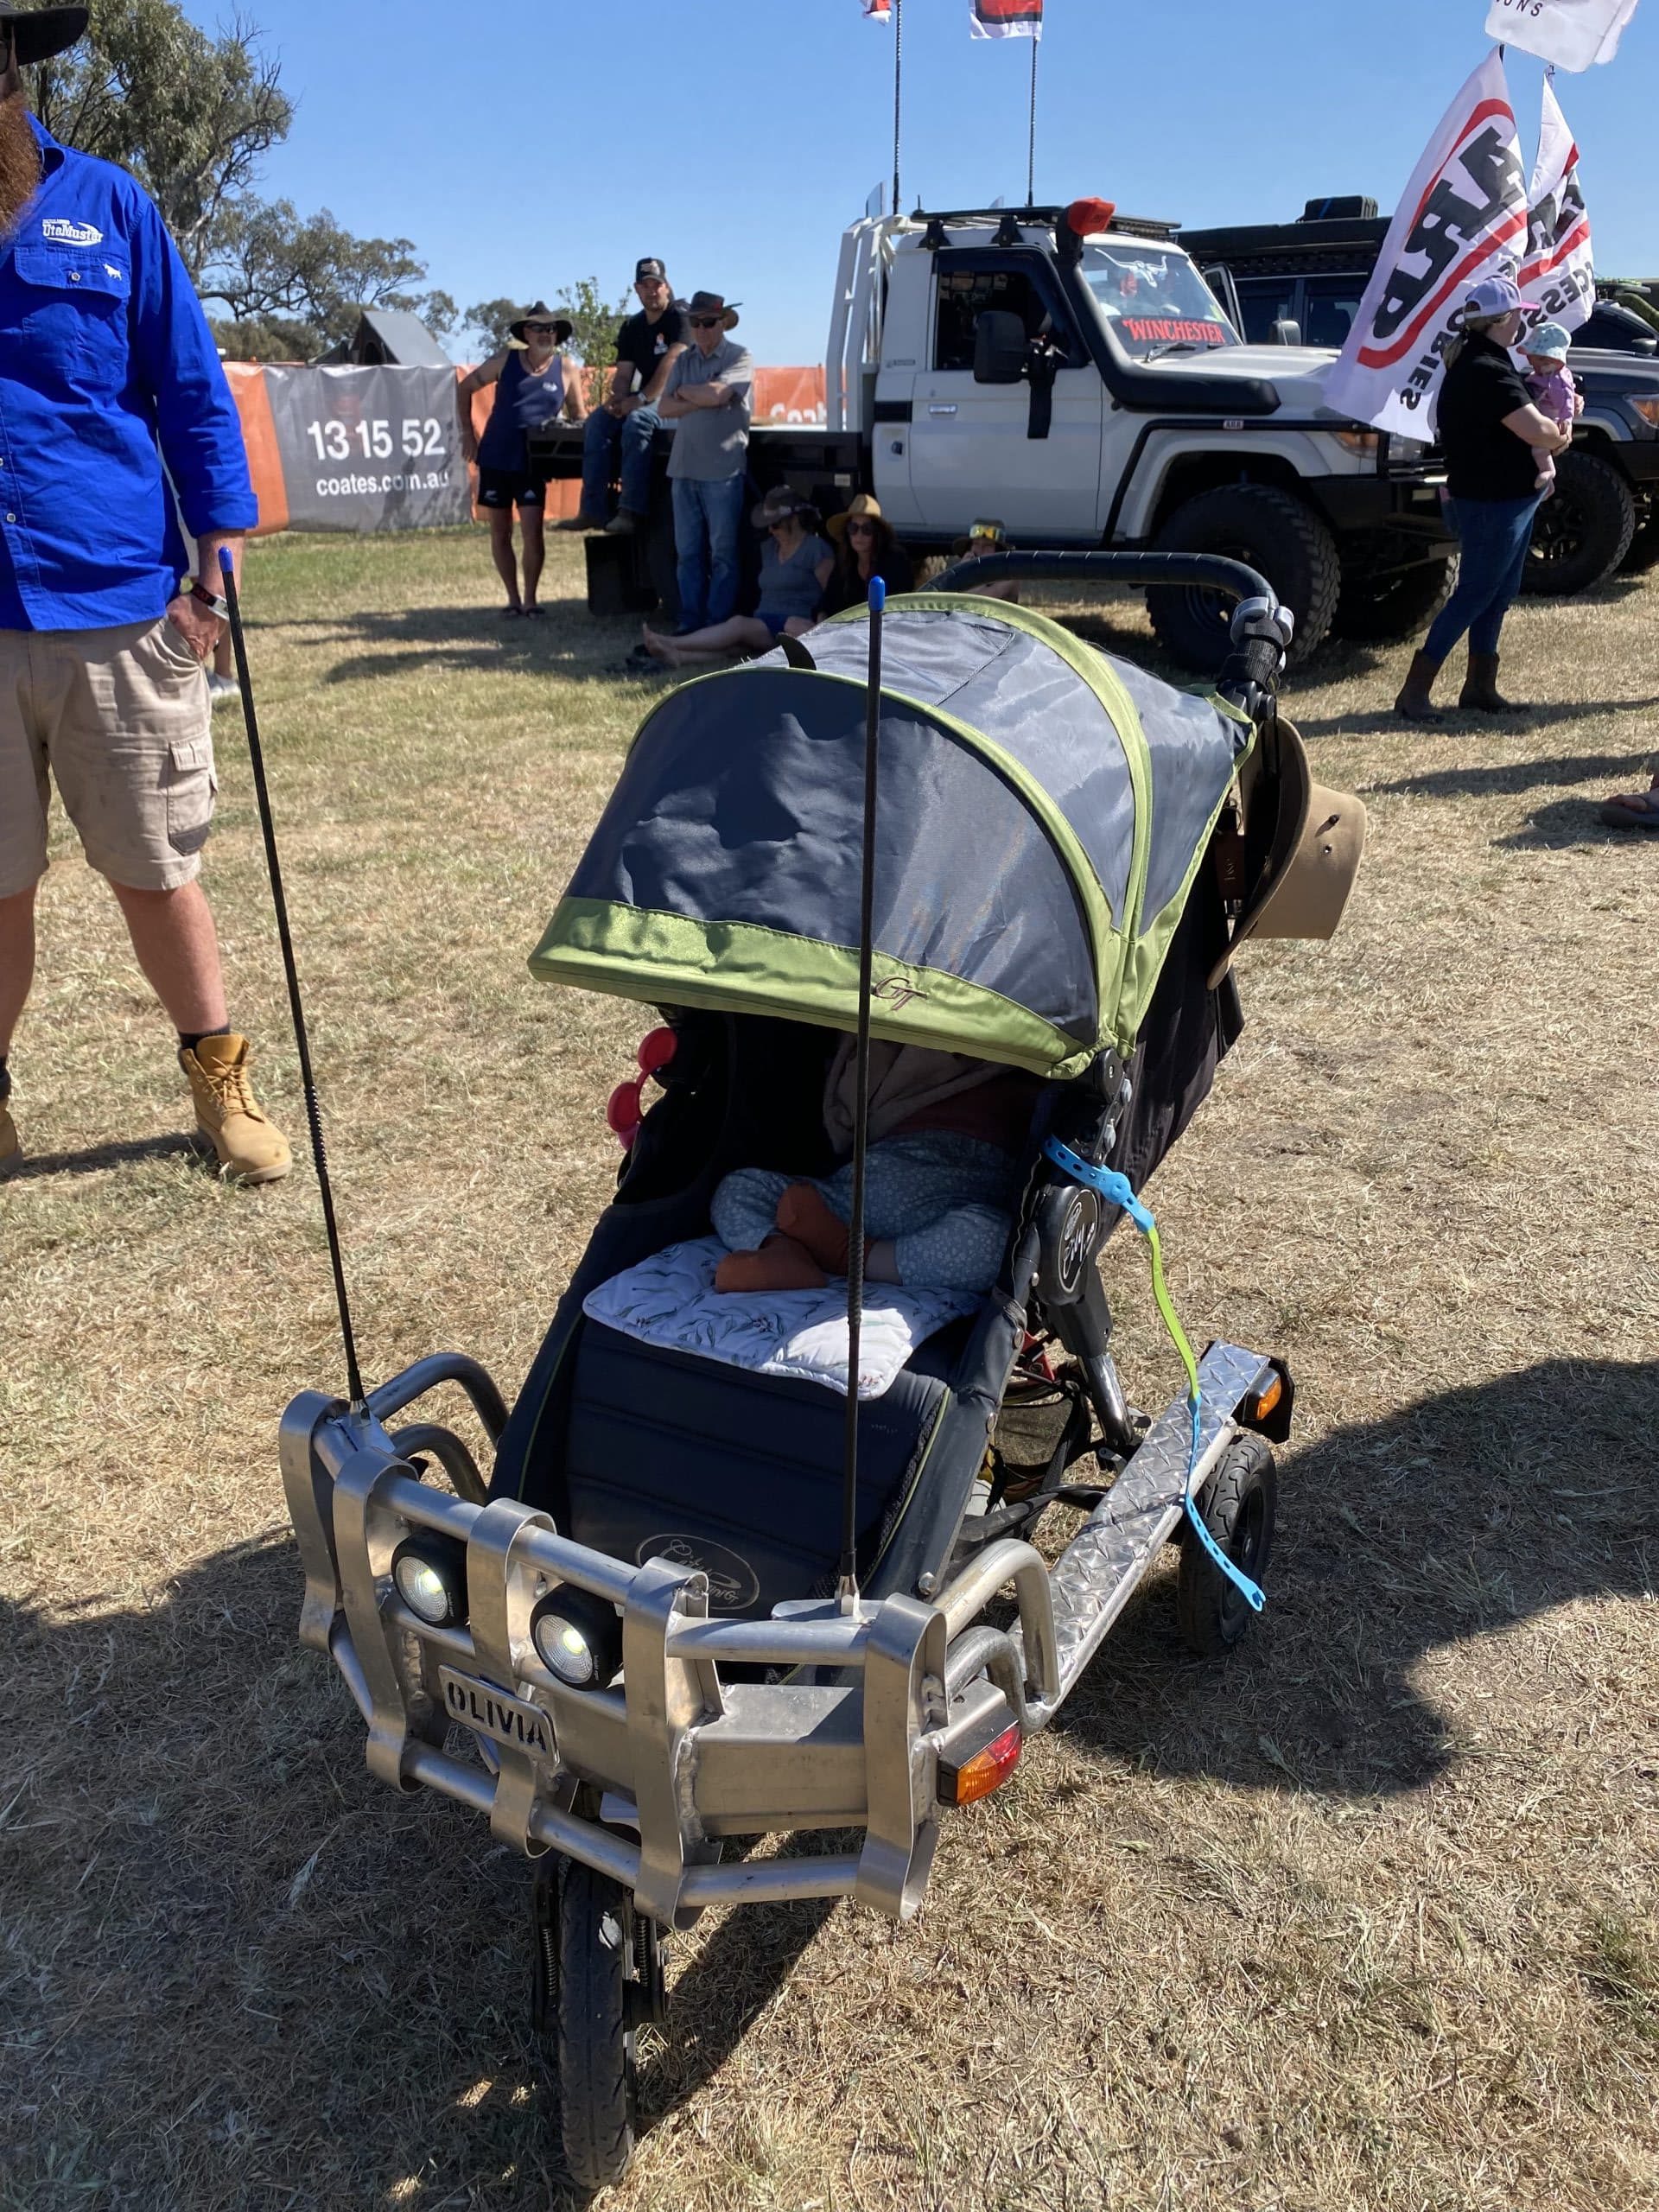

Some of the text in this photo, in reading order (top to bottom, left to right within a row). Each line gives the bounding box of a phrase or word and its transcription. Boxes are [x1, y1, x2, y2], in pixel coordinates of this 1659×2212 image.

[1122, 317, 1225, 344] WINCHESTER
[307, 418, 446, 460] 13 15 52
[316, 473, 449, 497] coates.com.au
[448, 1681, 547, 1752] OLIVIA
